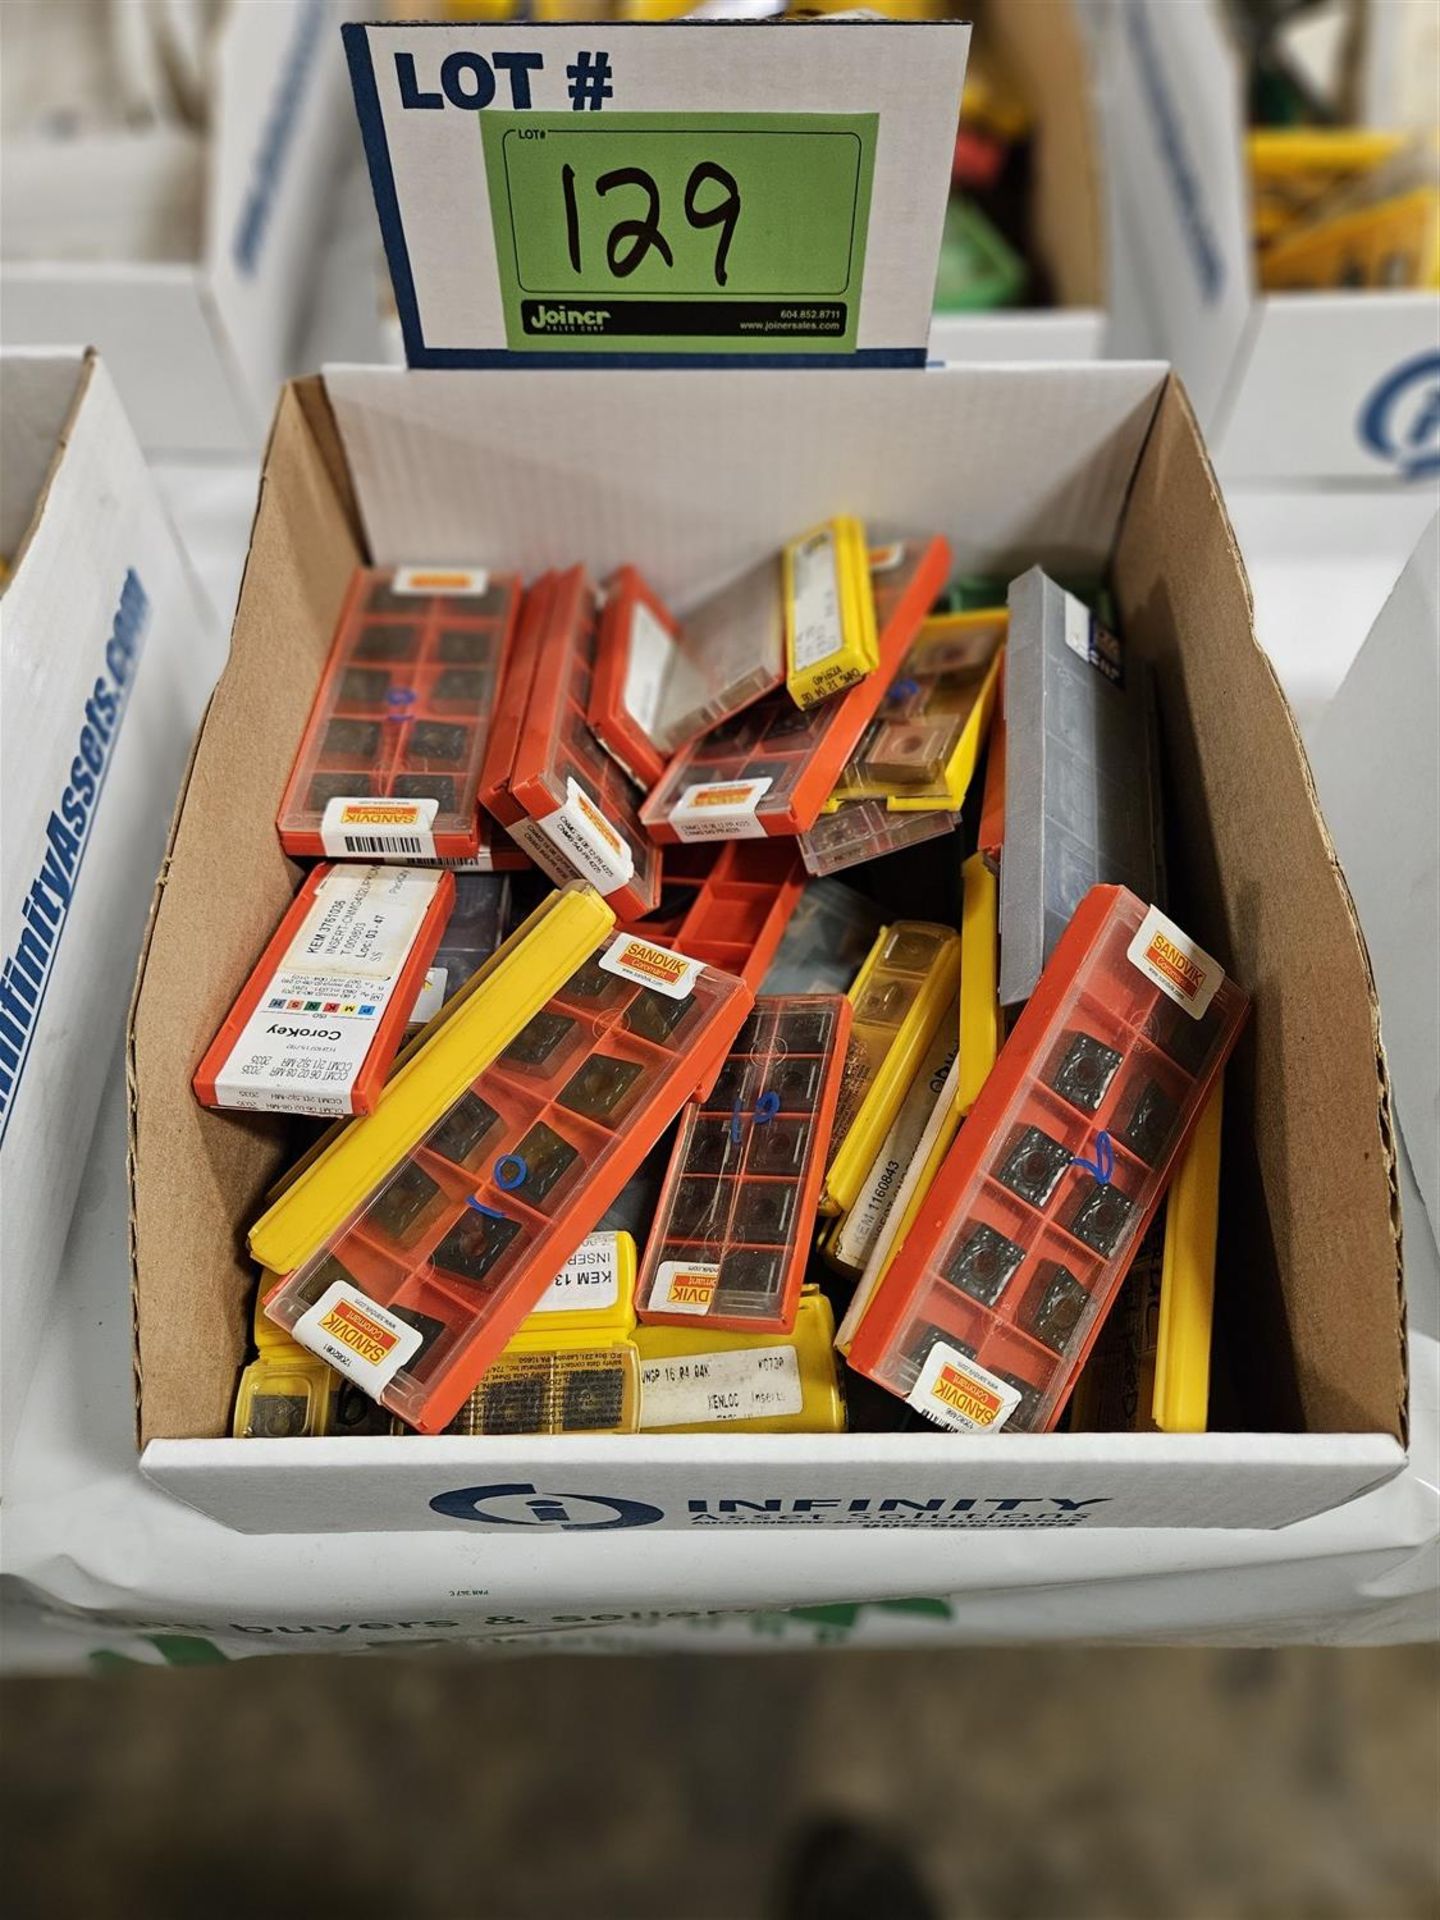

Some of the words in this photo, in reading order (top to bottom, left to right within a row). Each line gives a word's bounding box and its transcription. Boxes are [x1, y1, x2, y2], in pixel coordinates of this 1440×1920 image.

[394, 52, 543, 110] LOT
[566, 51, 614, 111] #
[518, 128, 547, 141] LOT#
[562, 162, 742, 286] 129
[531, 305, 611, 328] Joiner
[739, 321, 841, 331] www.joinersales.com
[780, 310, 840, 319] 604.852.8711
[343, 815, 415, 823] SANDVIK
[306, 934, 328, 953] KEM
[627, 942, 686, 974] SANDVIK
[630, 958, 667, 978] Coromant
[1152, 934, 1203, 985] SANDVIK
[1155, 955, 1187, 988] Coromant
[266, 1024, 341, 1040] CoroKey
[866, 1157, 901, 1212] 1160843
[554, 1273, 570, 1285] 13
[577, 1270, 611, 1284] KEM
[345, 1308, 384, 1342] Coromant
[322, 1309, 385, 1366] SANDVIK
[929, 1379, 996, 1425] SANDVIK
[687, 1498, 1113, 1514] INFINITY
[230, 1619, 460, 1637] buyers
[485, 1614, 528, 1625] &
